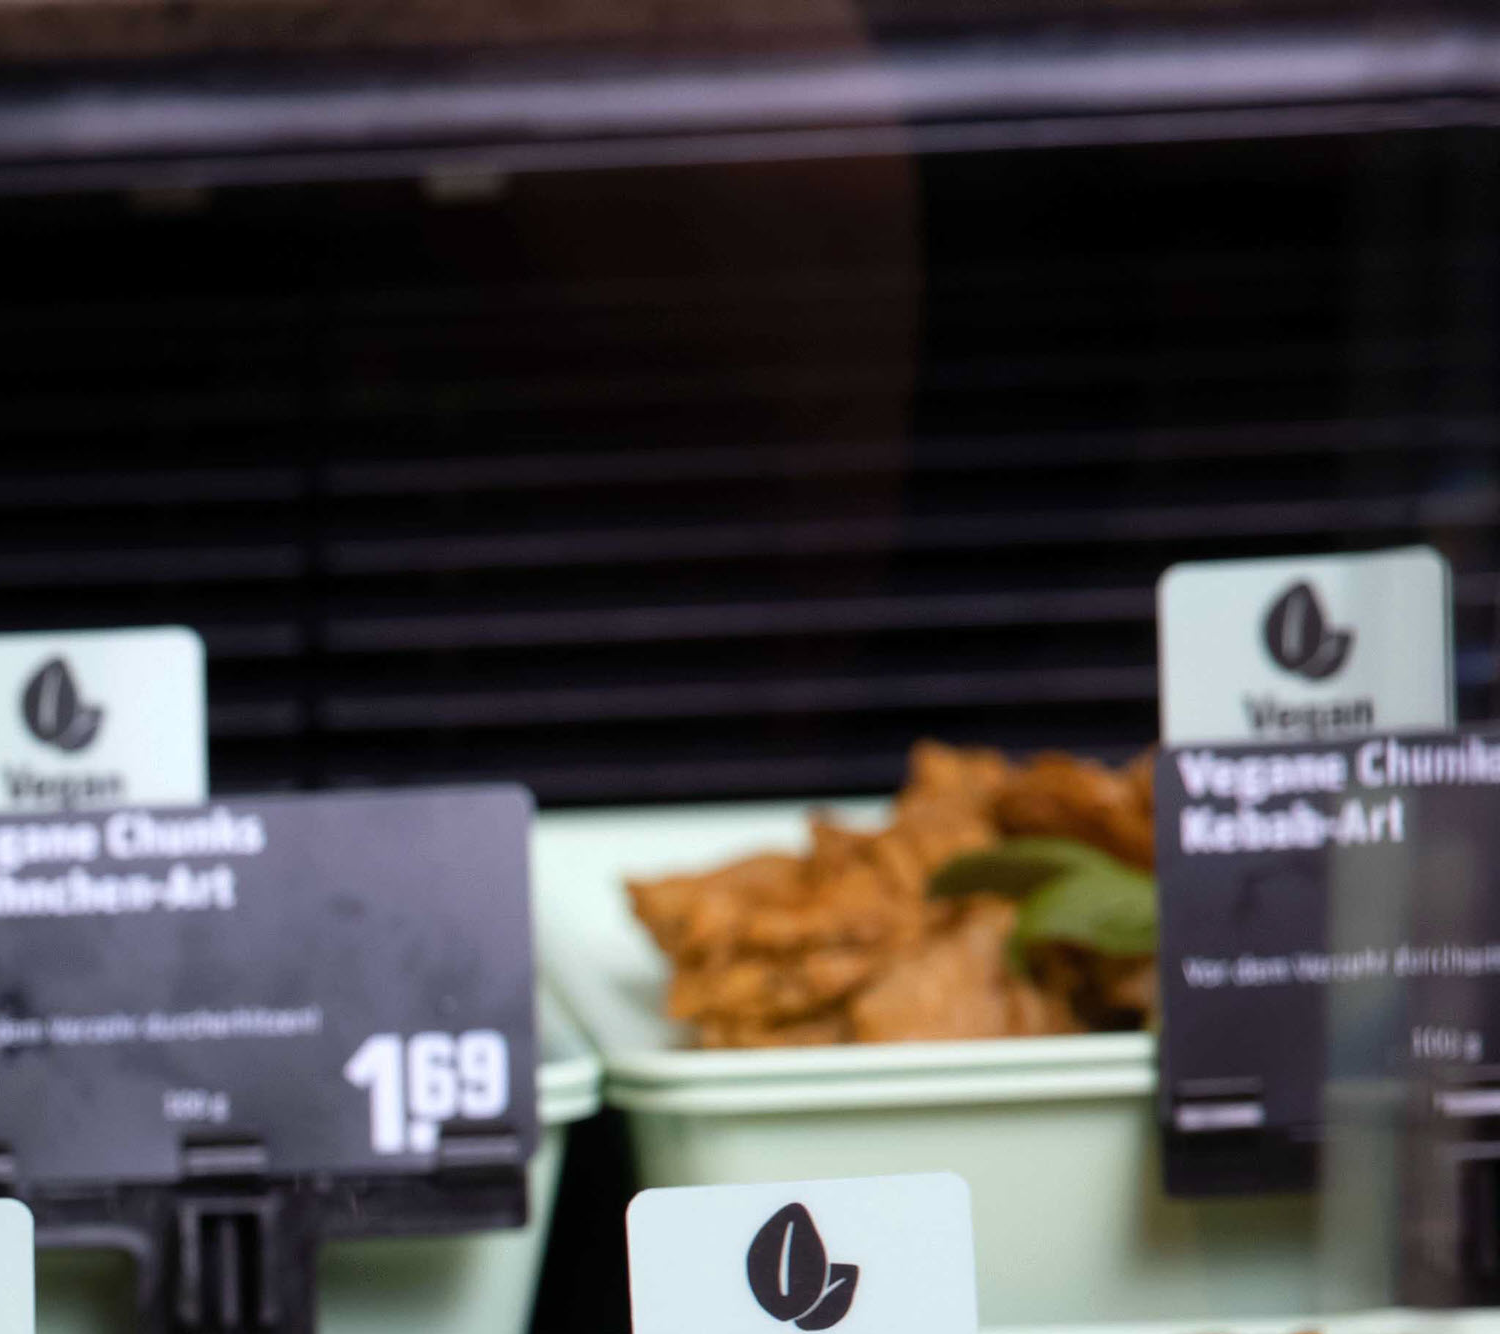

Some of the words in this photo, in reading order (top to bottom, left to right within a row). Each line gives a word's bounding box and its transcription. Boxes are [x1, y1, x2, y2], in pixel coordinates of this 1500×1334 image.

[1248, 694, 1375, 738] Vegan
[3, 766, 124, 806] Vegan
[1177, 747, 1346, 801] Vegane
[106, 807, 264, 860] Chunks
[1179, 796, 1404, 854] Kebab-Art
[344, 1030, 510, 1155] 1.69
